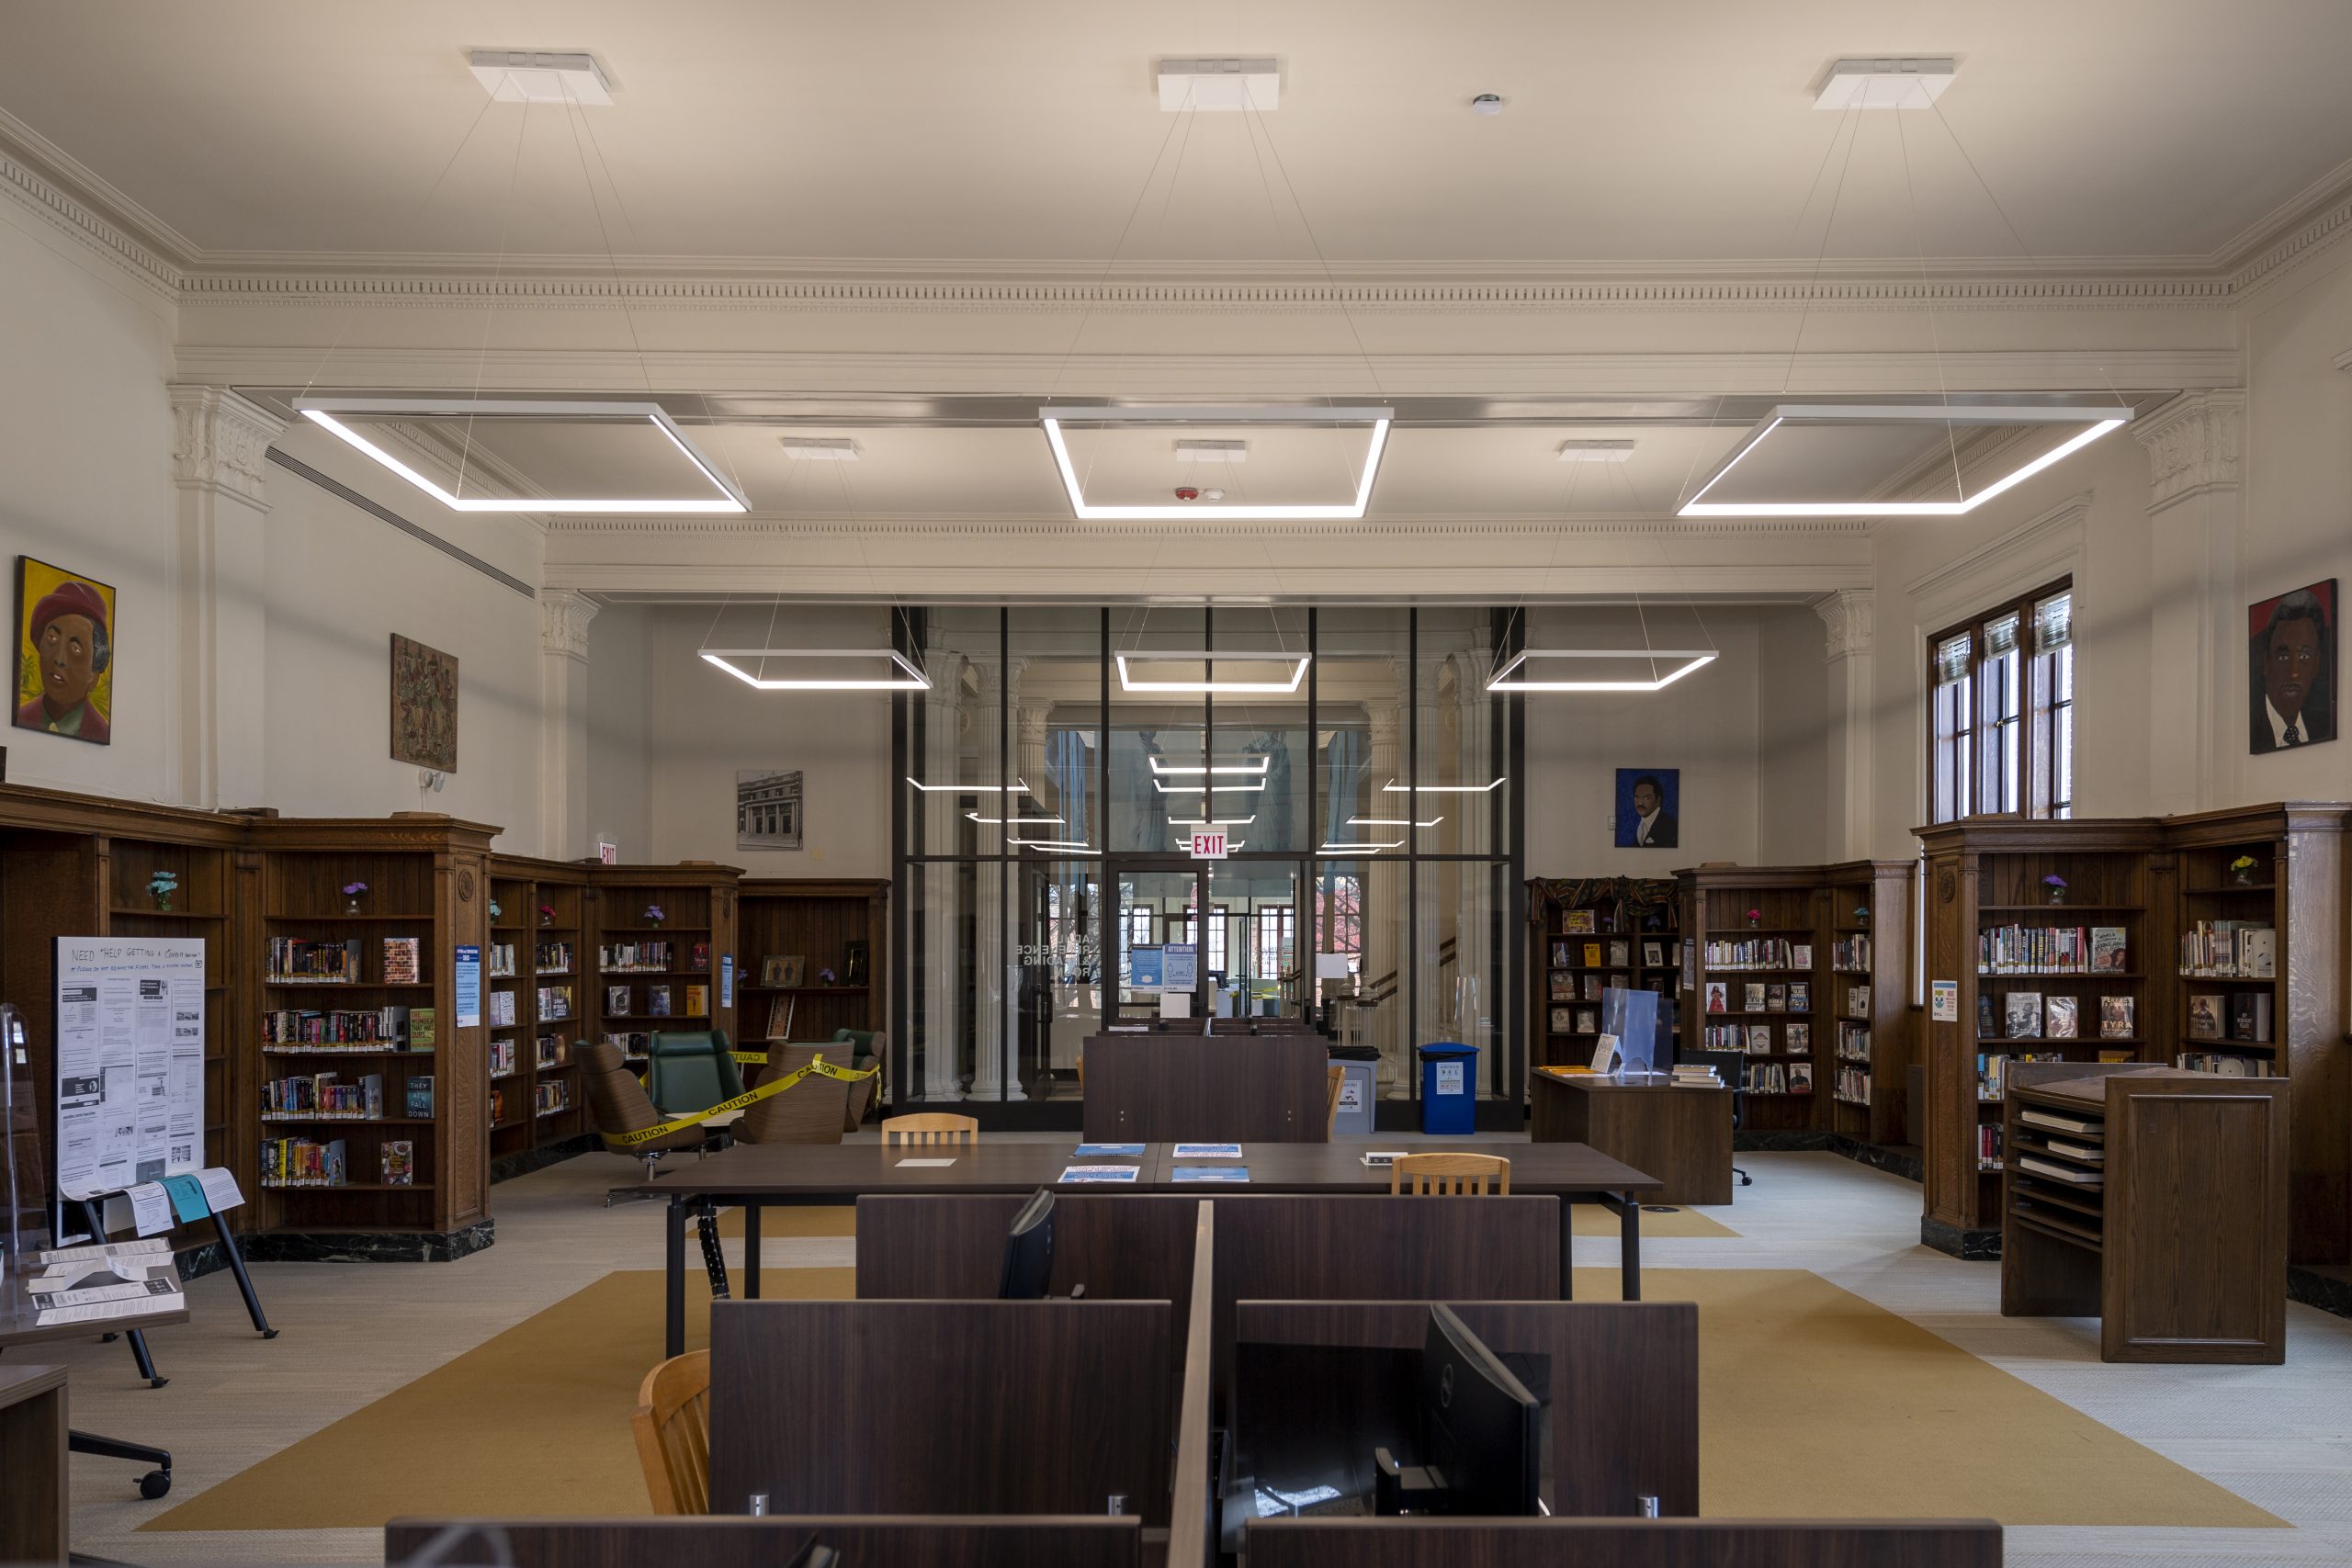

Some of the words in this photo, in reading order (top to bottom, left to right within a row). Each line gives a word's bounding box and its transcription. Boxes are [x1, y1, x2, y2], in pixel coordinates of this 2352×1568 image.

[1194, 835, 1224, 854] EXIT
[603, 846, 615, 865] EXIT
[72, 949, 95, 962] NEED
[127, 948, 154, 957] GETTING
[2101, 1021, 2132, 1029] TYRA
[708, 1091, 758, 1116] CAUTION
[622, 1125, 668, 1145] CAUTION
